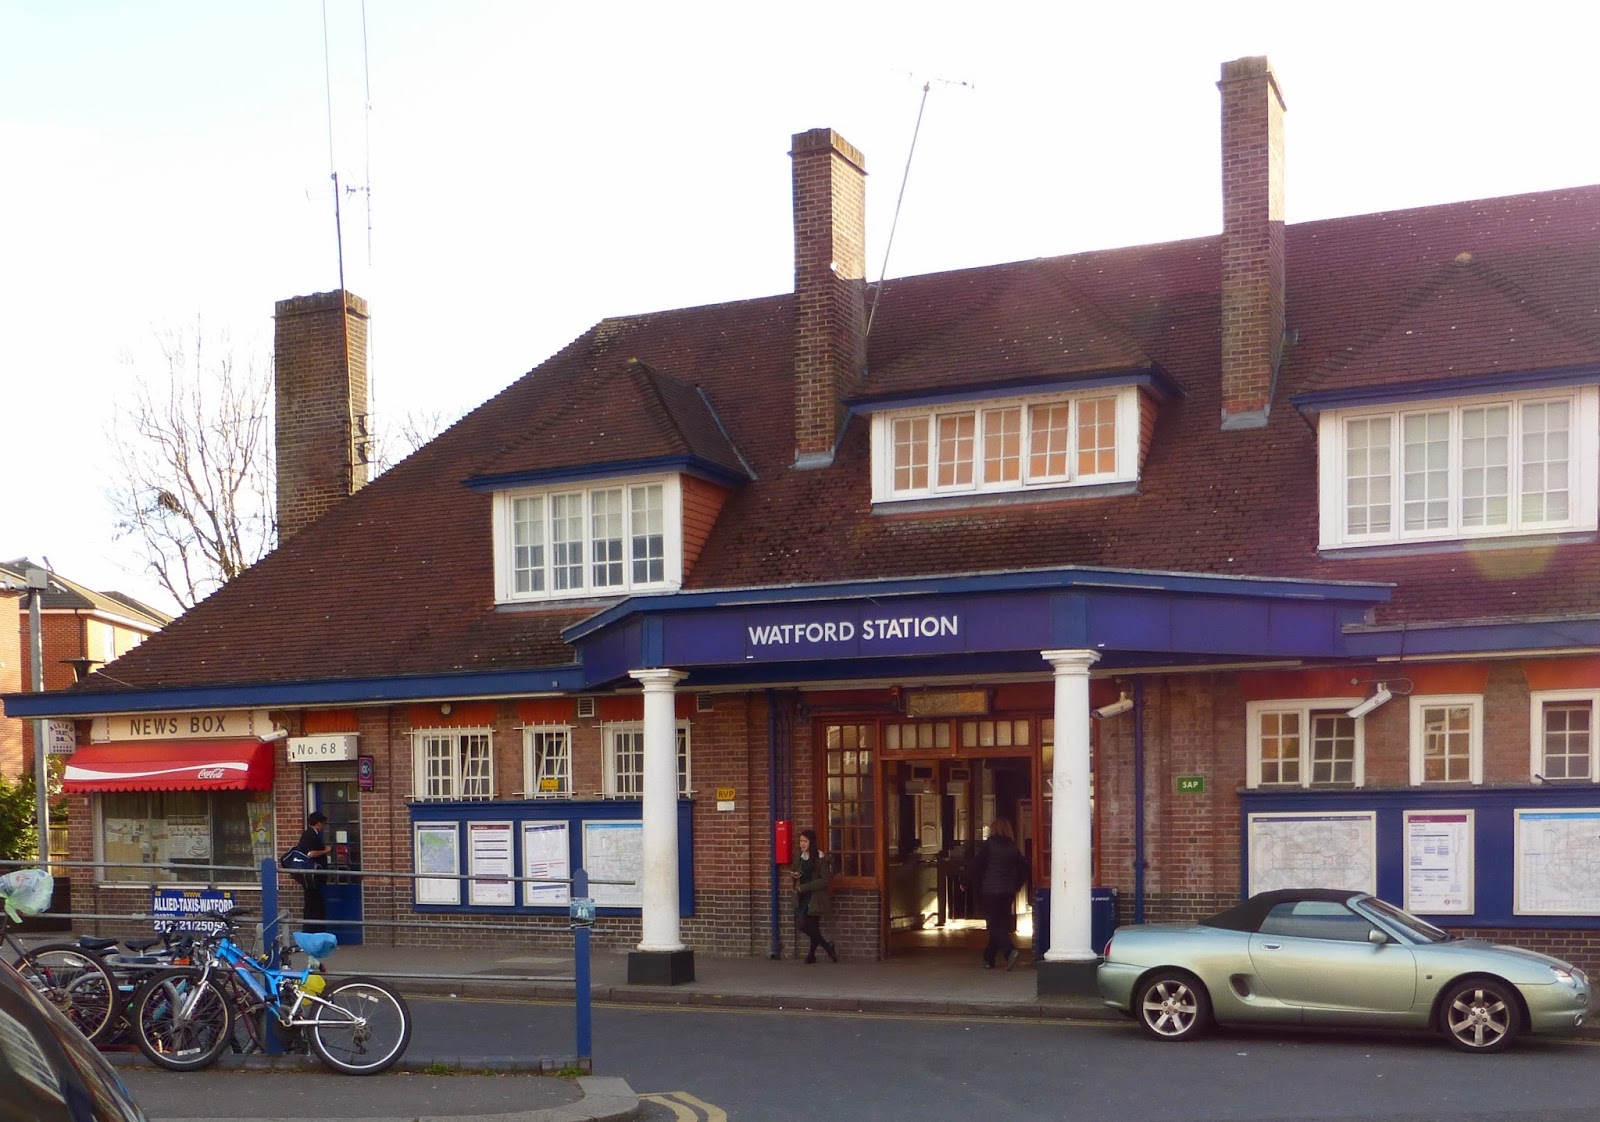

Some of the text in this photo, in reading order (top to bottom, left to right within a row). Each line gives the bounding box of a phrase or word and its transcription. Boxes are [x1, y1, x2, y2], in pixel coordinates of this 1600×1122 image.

[748, 615, 958, 646] WATFORD STATION
[130, 715, 225, 736] NEWS BOX
[1182, 781, 1198, 789] SAP
[718, 790, 734, 798] RVP
